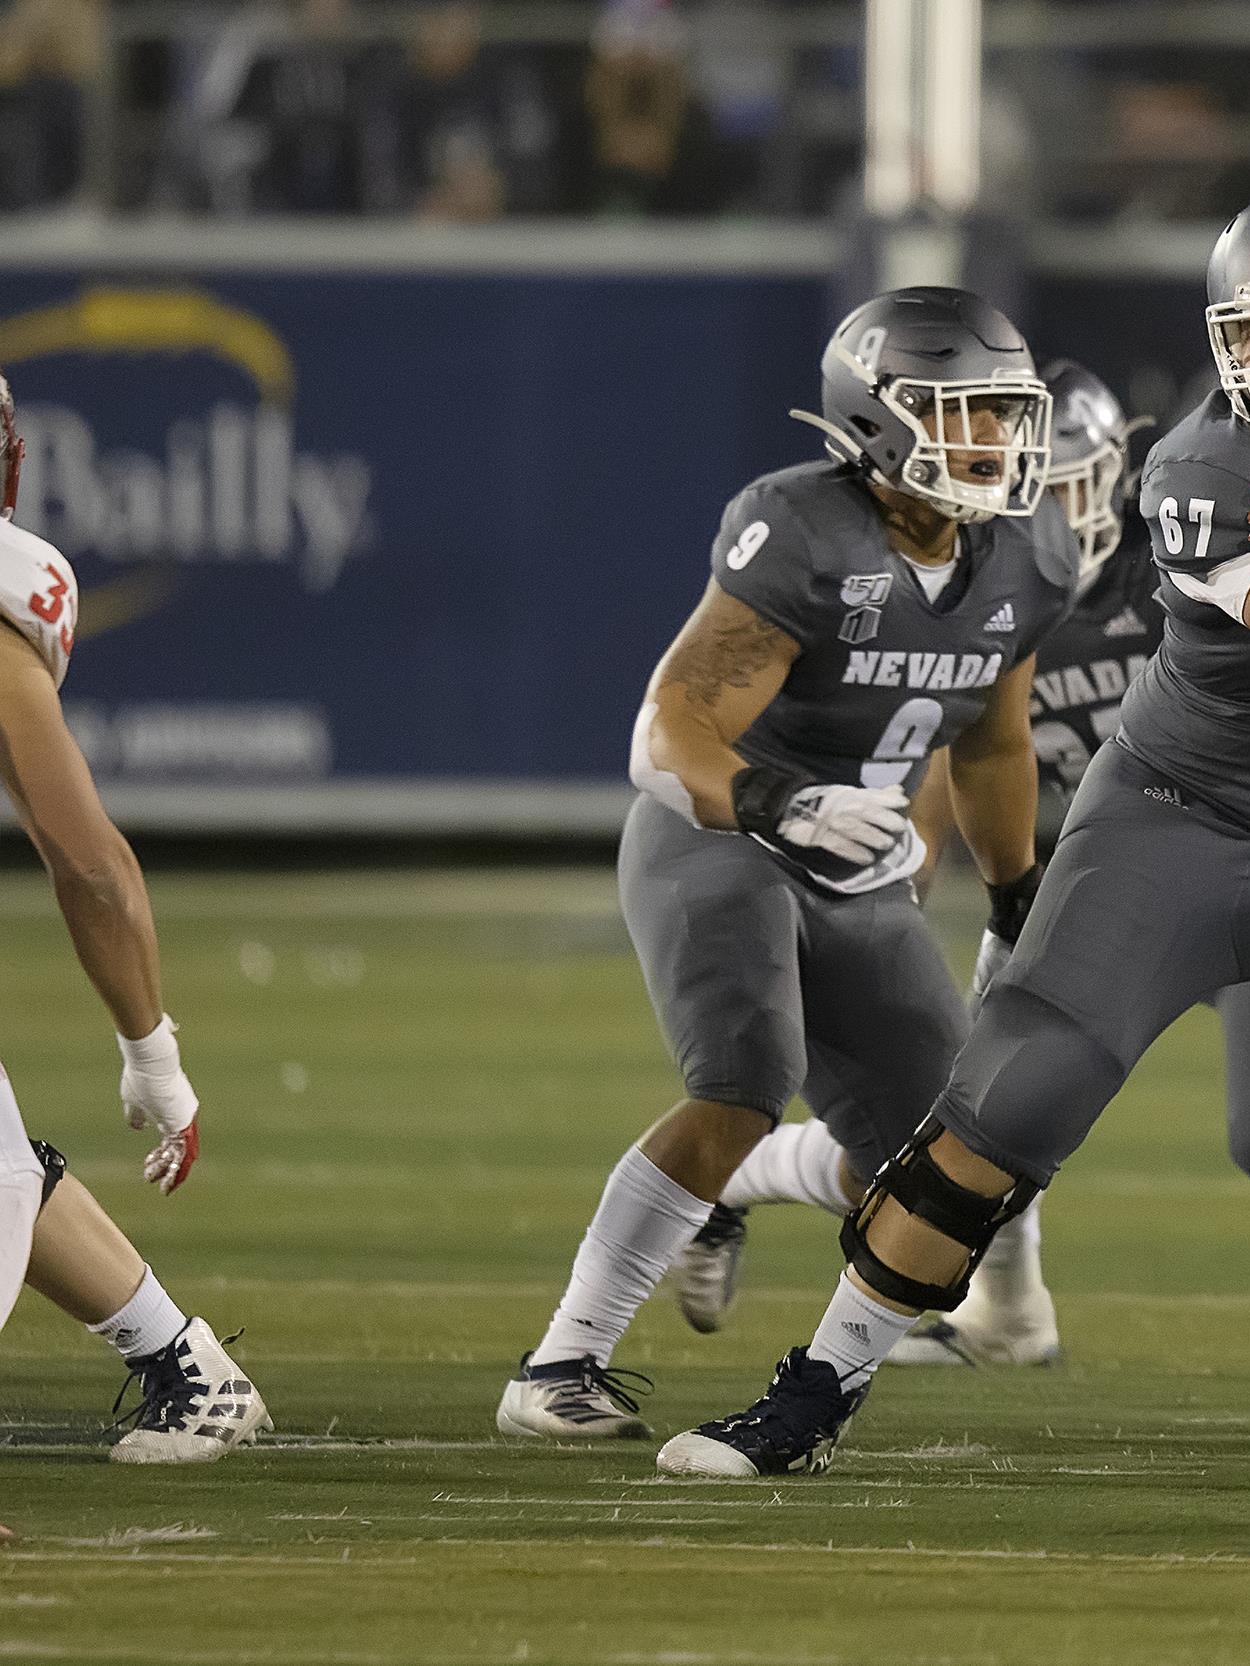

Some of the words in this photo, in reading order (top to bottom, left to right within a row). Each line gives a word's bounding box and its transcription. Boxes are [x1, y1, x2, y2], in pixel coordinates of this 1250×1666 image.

[727, 522, 769, 570] 9
[1158, 496, 1215, 557] 67
[841, 651, 1002, 690] NEVADA
